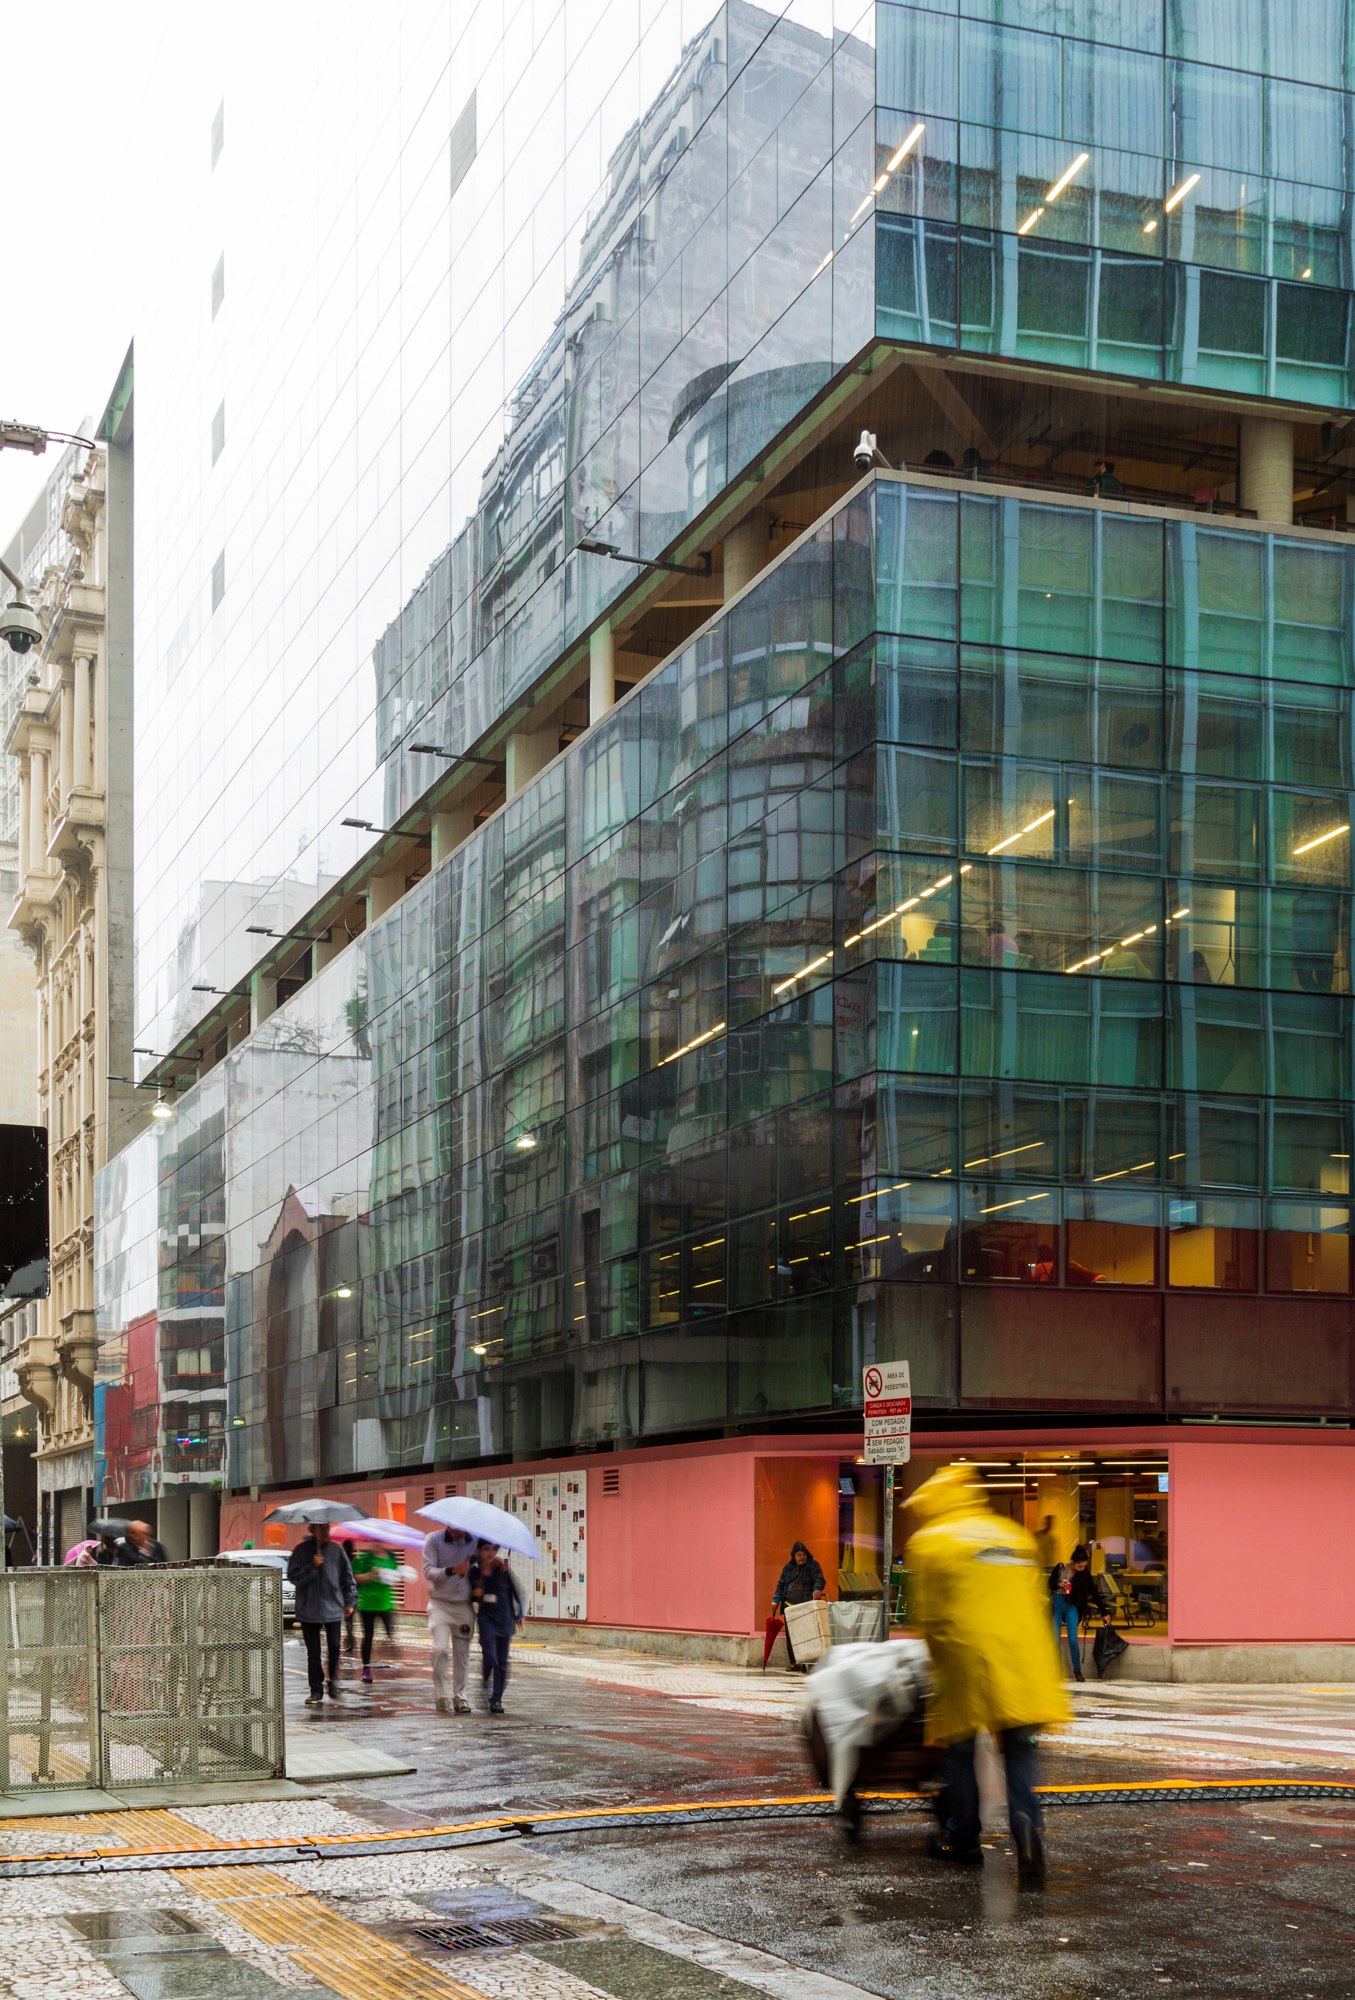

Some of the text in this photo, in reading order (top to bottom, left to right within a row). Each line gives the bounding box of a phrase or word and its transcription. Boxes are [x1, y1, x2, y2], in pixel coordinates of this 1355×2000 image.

[887, 1371, 898, 1379] ÁREA
[885, 1382, 908, 1390] PEDESTRES
[872, 1416, 906, 1427] COM PEDÁGIO
[883, 1436, 904, 1445] PEDÁGIO
[886, 1446, 897, 1454] após
[877, 1454, 896, 1462] Domingo
[1096, 1542, 1101, 1550] 5
